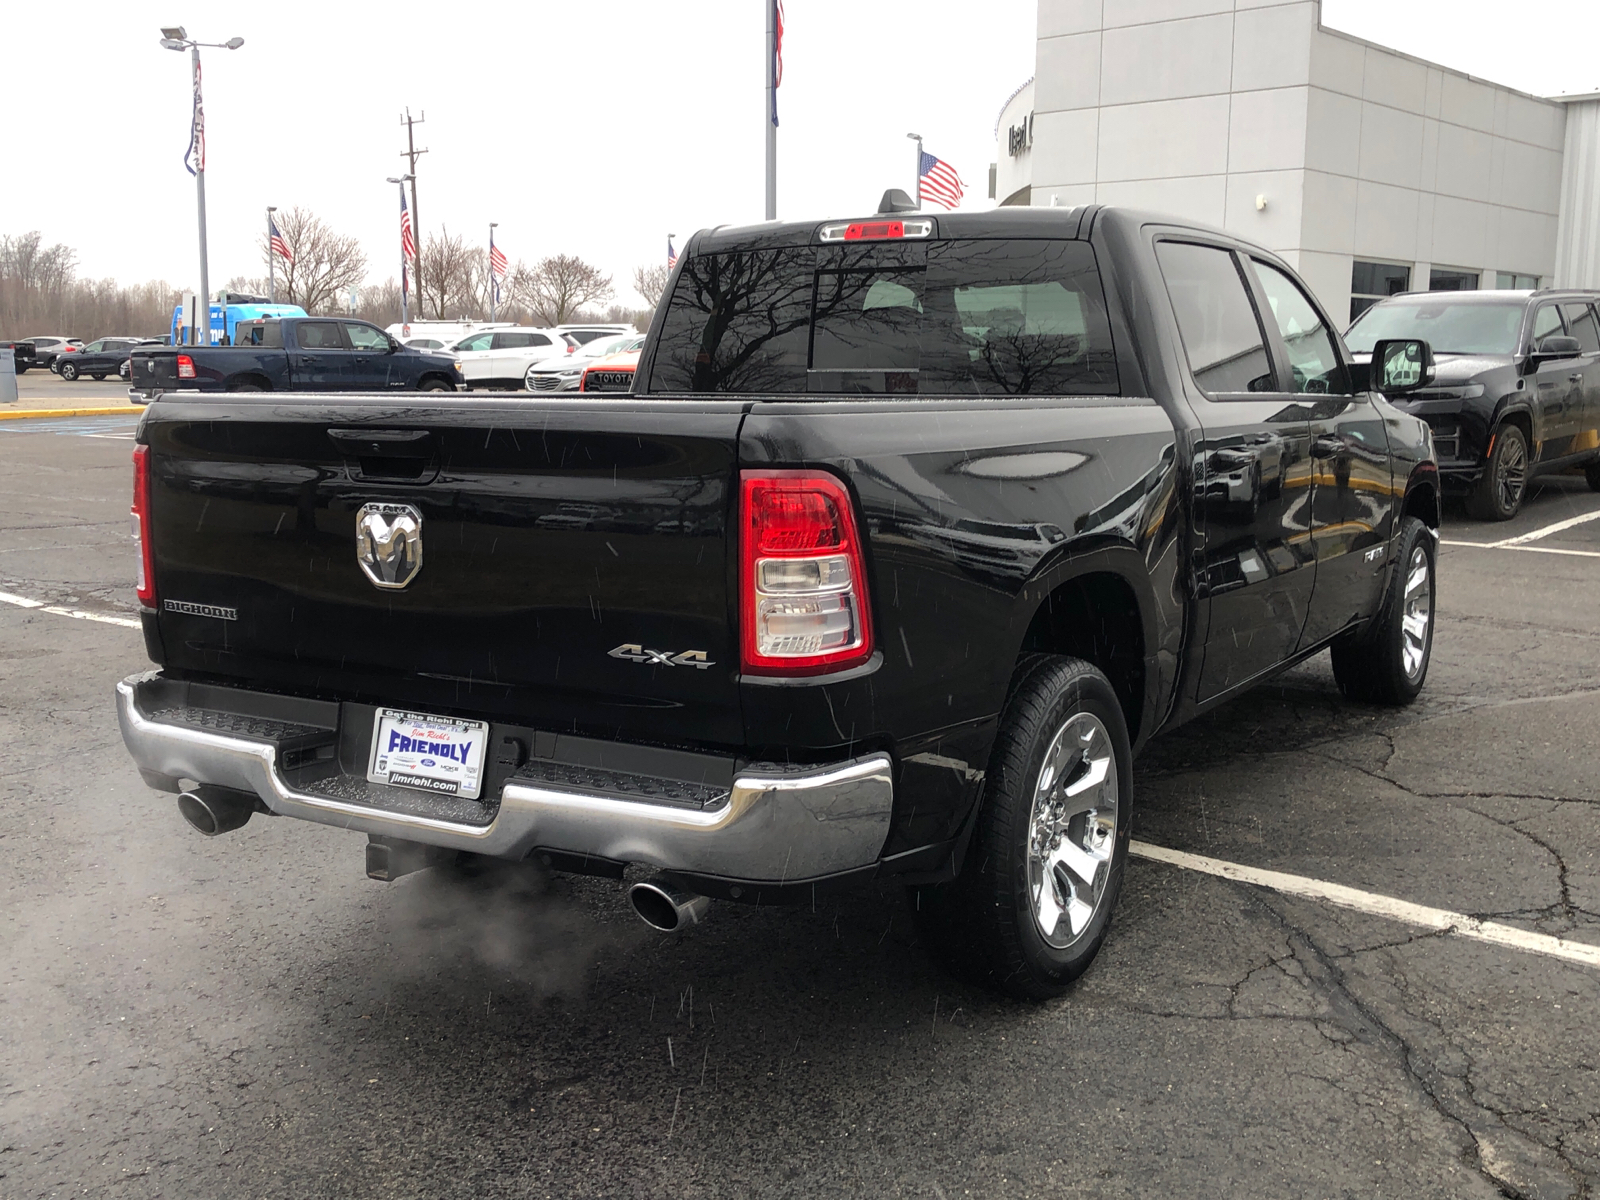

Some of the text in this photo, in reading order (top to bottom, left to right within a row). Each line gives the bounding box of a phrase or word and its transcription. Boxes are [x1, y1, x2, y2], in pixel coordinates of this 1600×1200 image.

[598, 374, 633, 383] TOYOTA
[368, 504, 408, 514] RAM
[163, 599, 238, 621] BIGHORN
[385, 710, 405, 719] Get
[407, 713, 424, 721] the
[455, 718, 479, 728] Deal
[410, 729, 451, 741] Jim Riehl's
[388, 728, 473, 766] FRIENDLY
[390, 773, 457, 791] jimriehl.com
